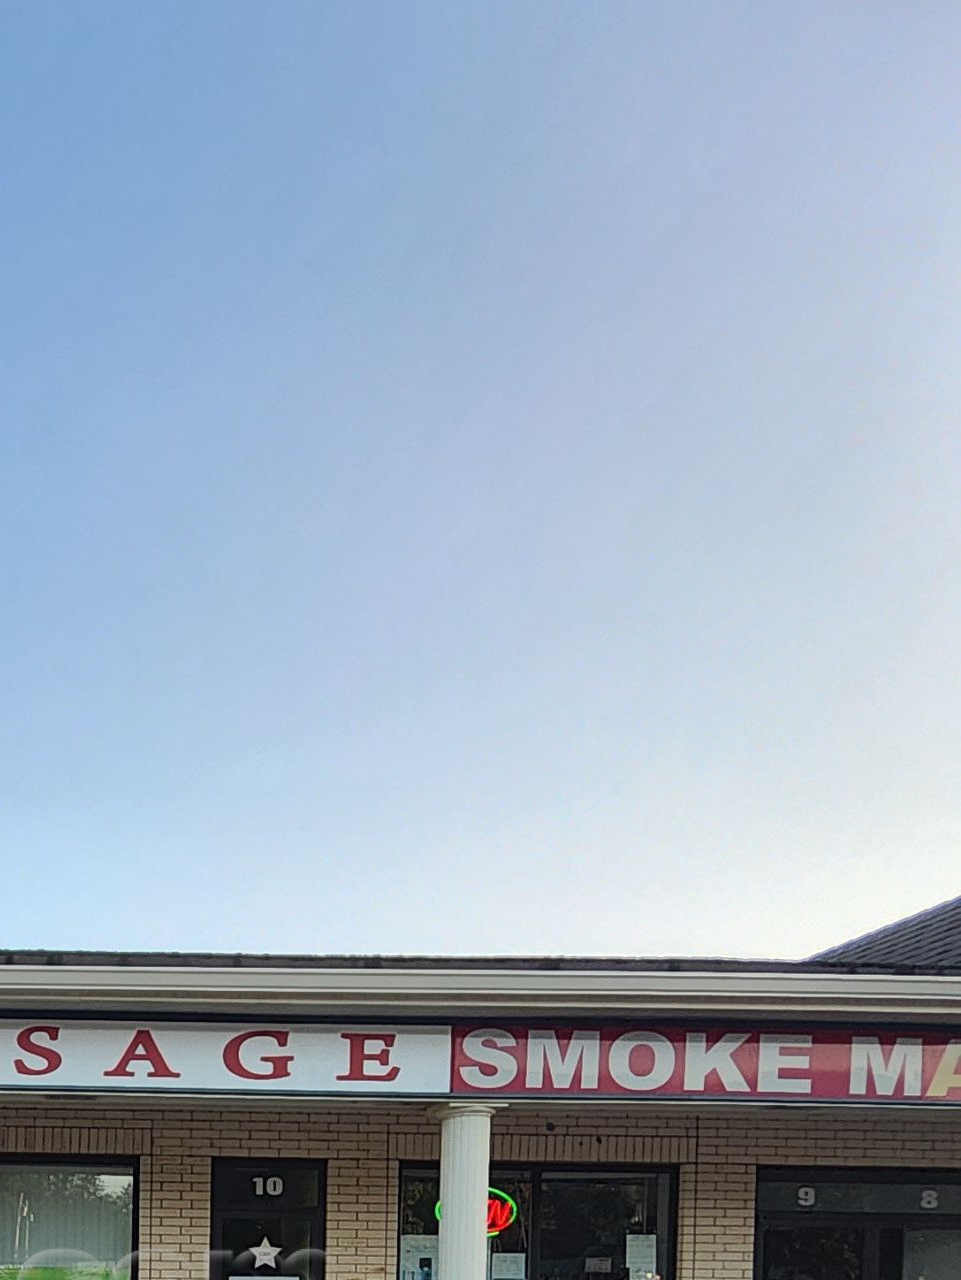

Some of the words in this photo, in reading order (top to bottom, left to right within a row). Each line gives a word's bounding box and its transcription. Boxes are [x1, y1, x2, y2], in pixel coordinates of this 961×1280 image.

[458, 1027, 813, 1095] SMOKE
[252, 1176, 284, 1196] 10
[797, 1186, 816, 1206] 9
[920, 1189, 939, 1209] 8
